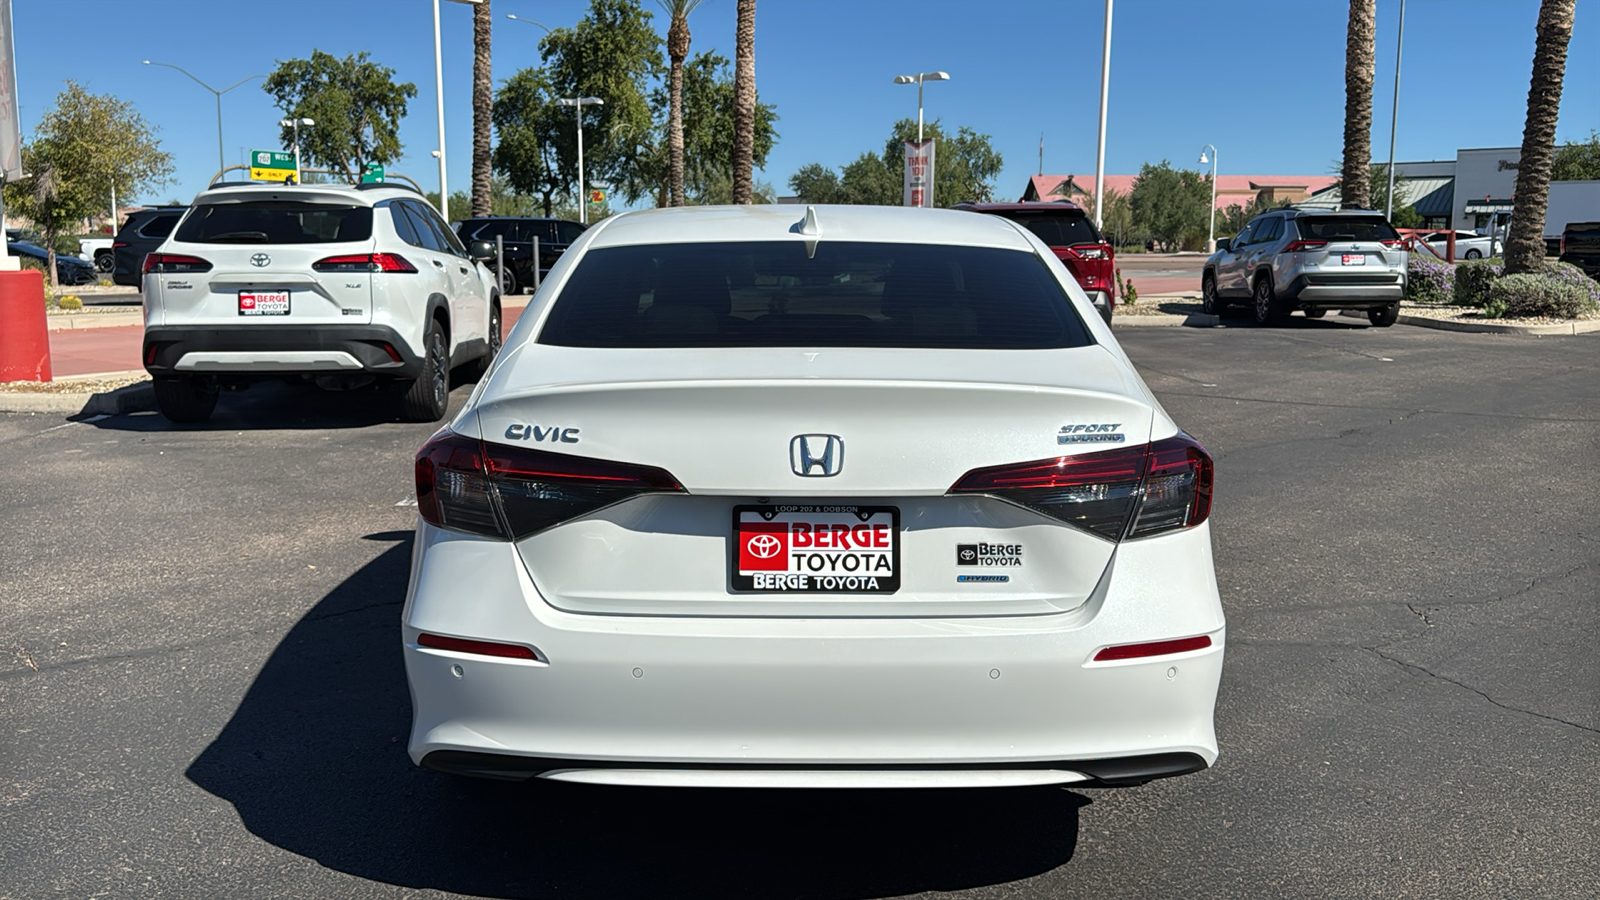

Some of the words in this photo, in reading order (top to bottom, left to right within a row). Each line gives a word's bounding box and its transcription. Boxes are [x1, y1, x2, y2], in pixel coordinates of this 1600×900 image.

[257, 294, 288, 303] BERGE
[504, 423, 580, 444] CIVIC
[1058, 423, 1122, 434] SPORT
[1060, 434, 1122, 443] TOURING
[791, 522, 890, 550] BERGE
[979, 542, 1022, 556] BERGE
[792, 553, 892, 572] TOYOTA
[979, 556, 1022, 566] TOYOTA
[753, 573, 809, 591] BERGE
[814, 577, 880, 590] TOYOTA
